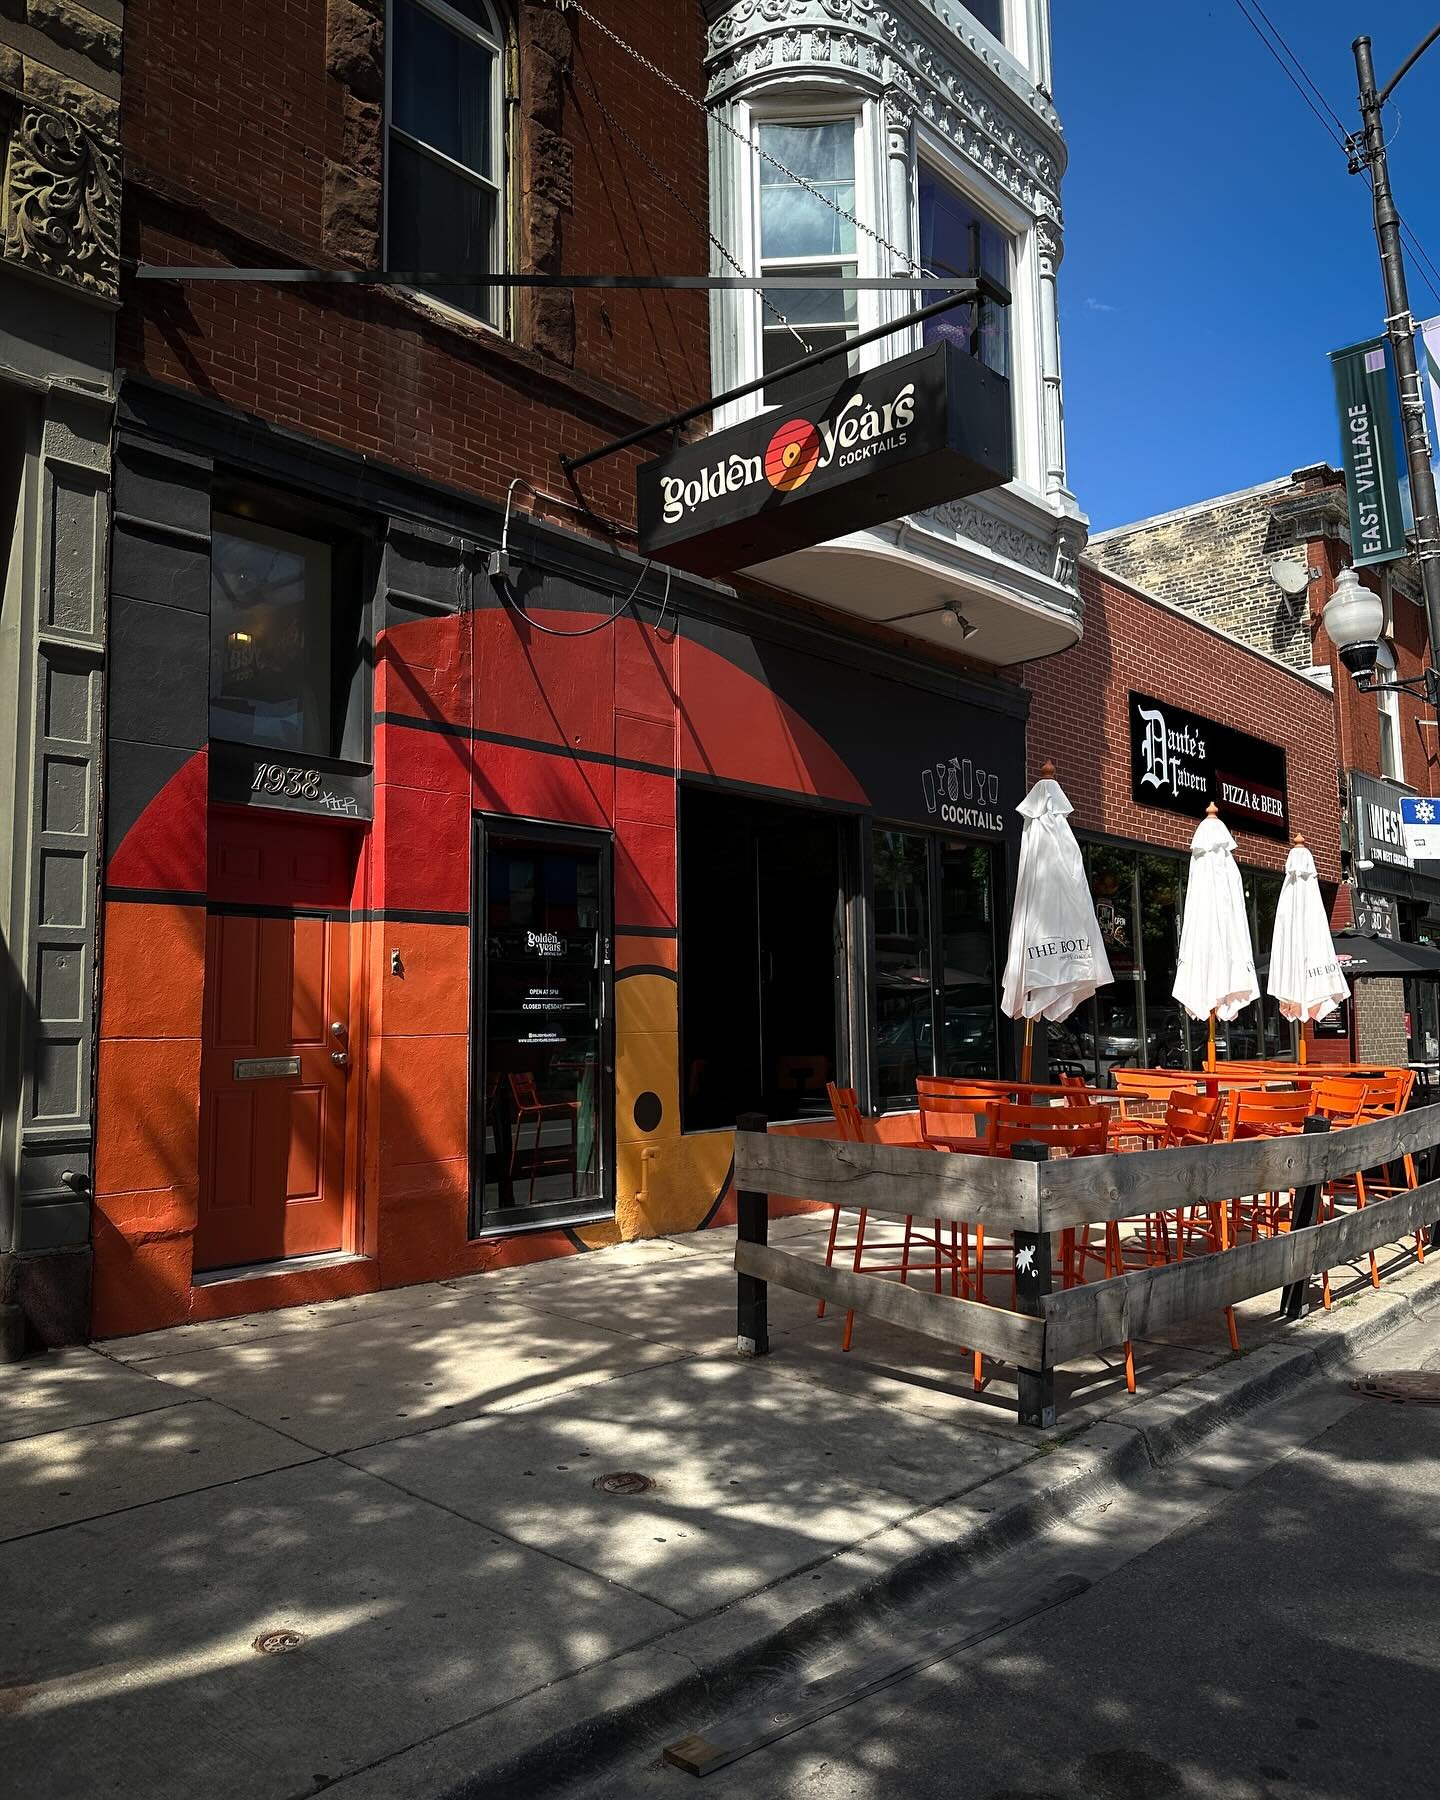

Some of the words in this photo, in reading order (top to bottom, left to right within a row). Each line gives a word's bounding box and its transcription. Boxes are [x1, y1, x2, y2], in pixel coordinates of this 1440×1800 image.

[660, 454, 764, 524] golden
[817, 383, 915, 468] years
[838, 432, 907, 468] COCKTAILS
[1348, 403, 1375, 493] VILLAGE
[1359, 502, 1382, 554] EAST
[1138, 704, 1207, 790] Dante's
[251, 763, 321, 799] 1938
[1169, 755, 1207, 797] Tavern
[941, 804, 1004, 832] COCKTAILS
[1222, 782, 1250, 809] PIZZA
[1251, 792, 1261, 811] &
[1261, 795, 1284, 818] BEER
[527, 931, 558, 947] golden
[537, 942, 562, 956] years
[1028, 943, 1058, 960] THE
